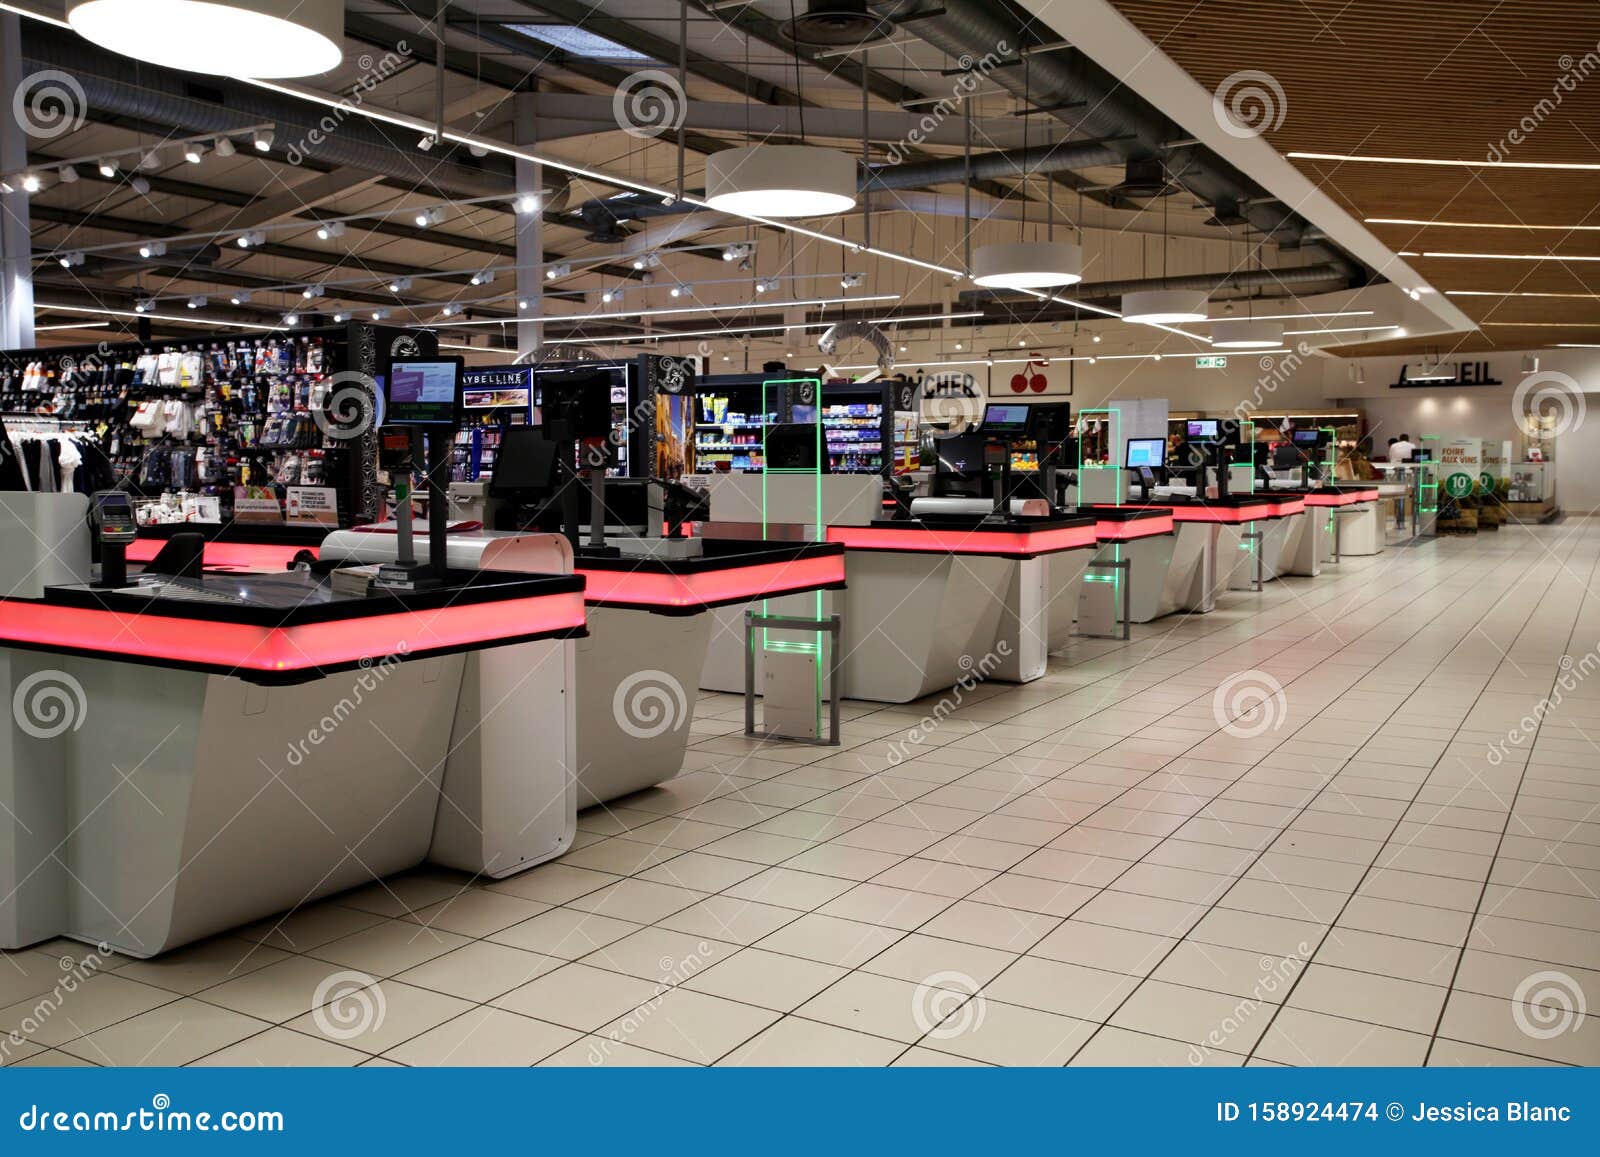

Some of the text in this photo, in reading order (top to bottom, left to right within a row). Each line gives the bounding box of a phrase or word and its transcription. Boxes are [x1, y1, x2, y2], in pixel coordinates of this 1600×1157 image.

[1442, 447, 1465, 456] FOIRE
[1442, 456, 1478, 464] AUX VINS
